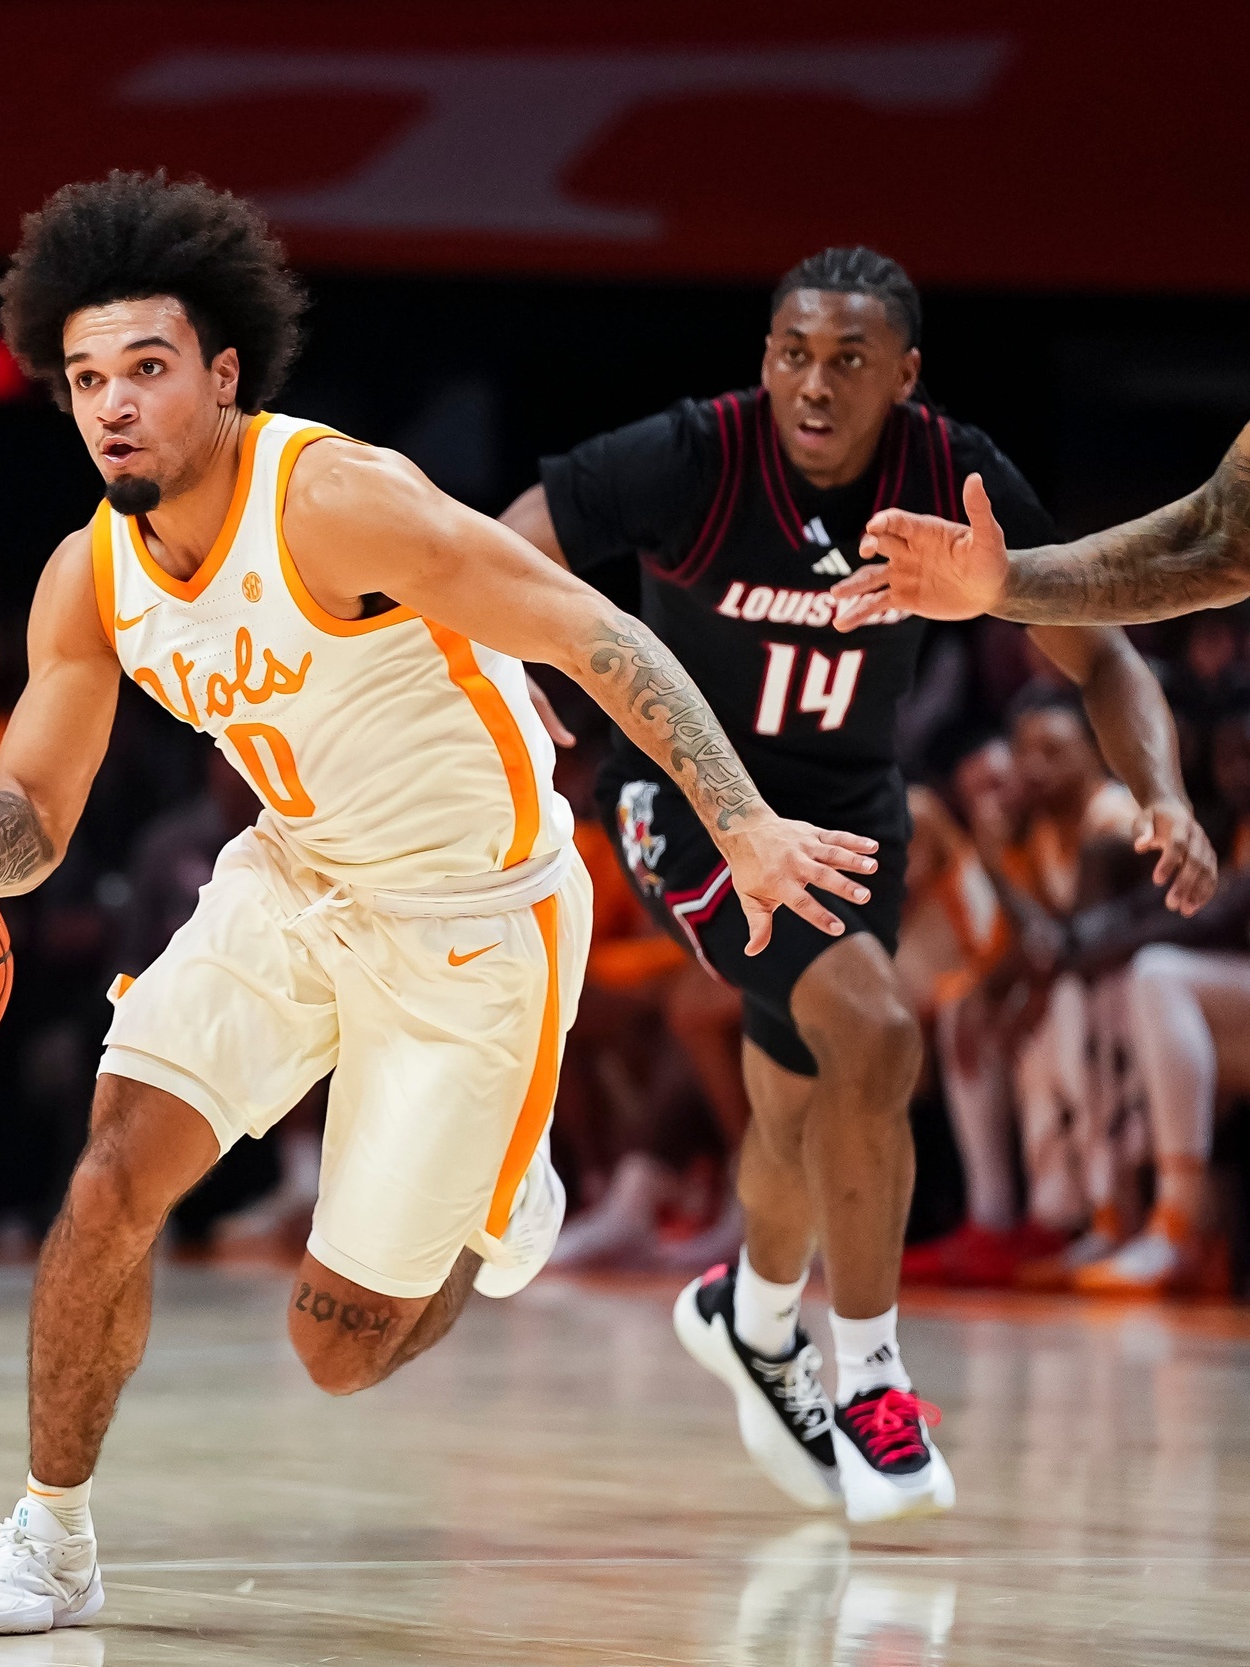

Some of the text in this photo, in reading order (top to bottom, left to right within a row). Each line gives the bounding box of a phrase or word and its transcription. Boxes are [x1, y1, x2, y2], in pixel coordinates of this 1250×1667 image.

[133, 626, 313, 727] Vols
[754, 641, 865, 737] 14
[224, 722, 316, 818] 0
